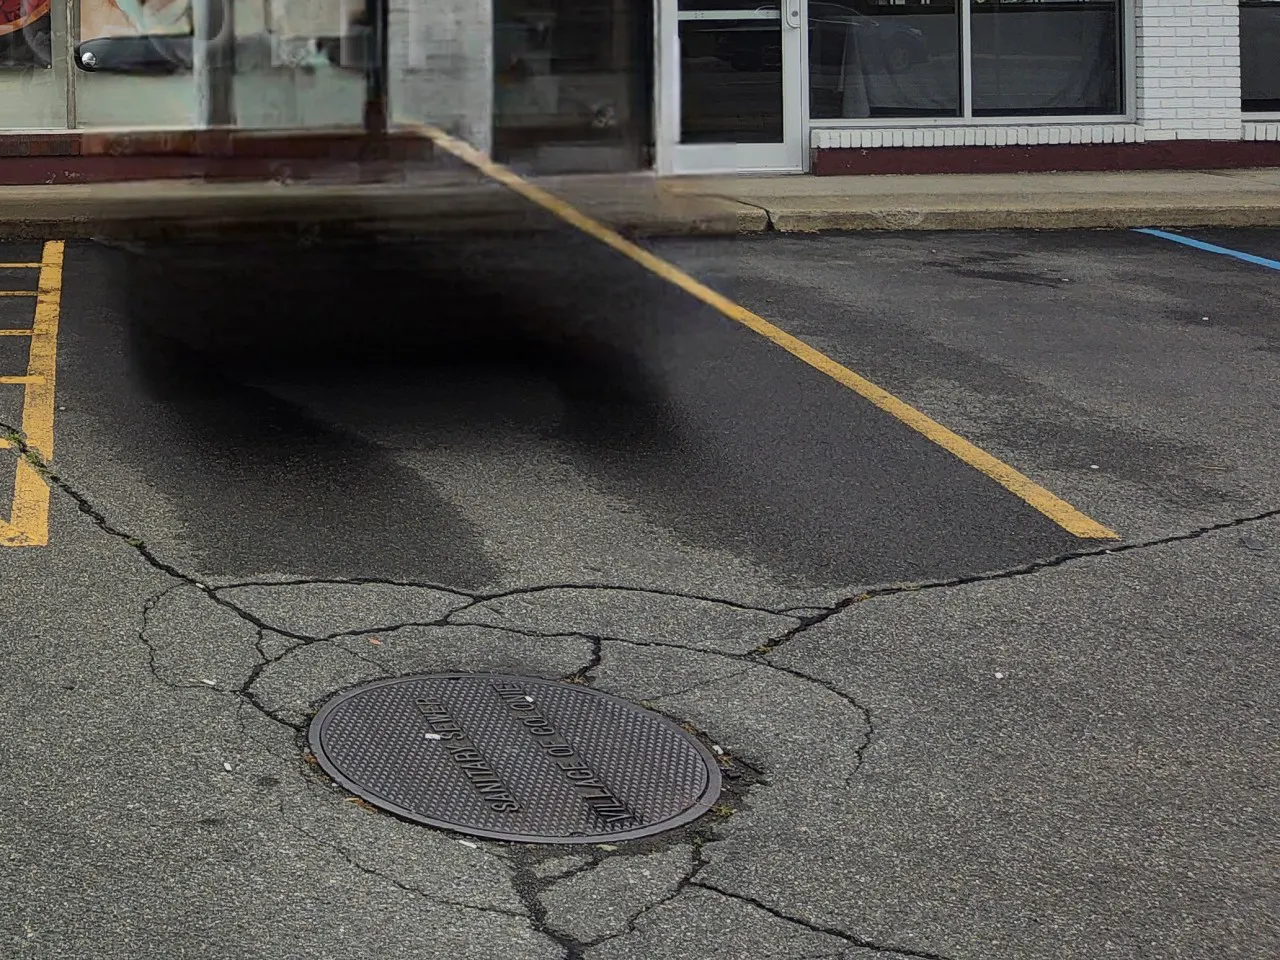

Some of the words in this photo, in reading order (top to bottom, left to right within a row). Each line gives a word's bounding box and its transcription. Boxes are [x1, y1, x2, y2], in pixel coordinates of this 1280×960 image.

[415, 696, 466, 740] SEWER
[537, 739, 574, 758] OF
[445, 745, 520, 814] SANITARY
[557, 760, 635, 824] VILLAGE
